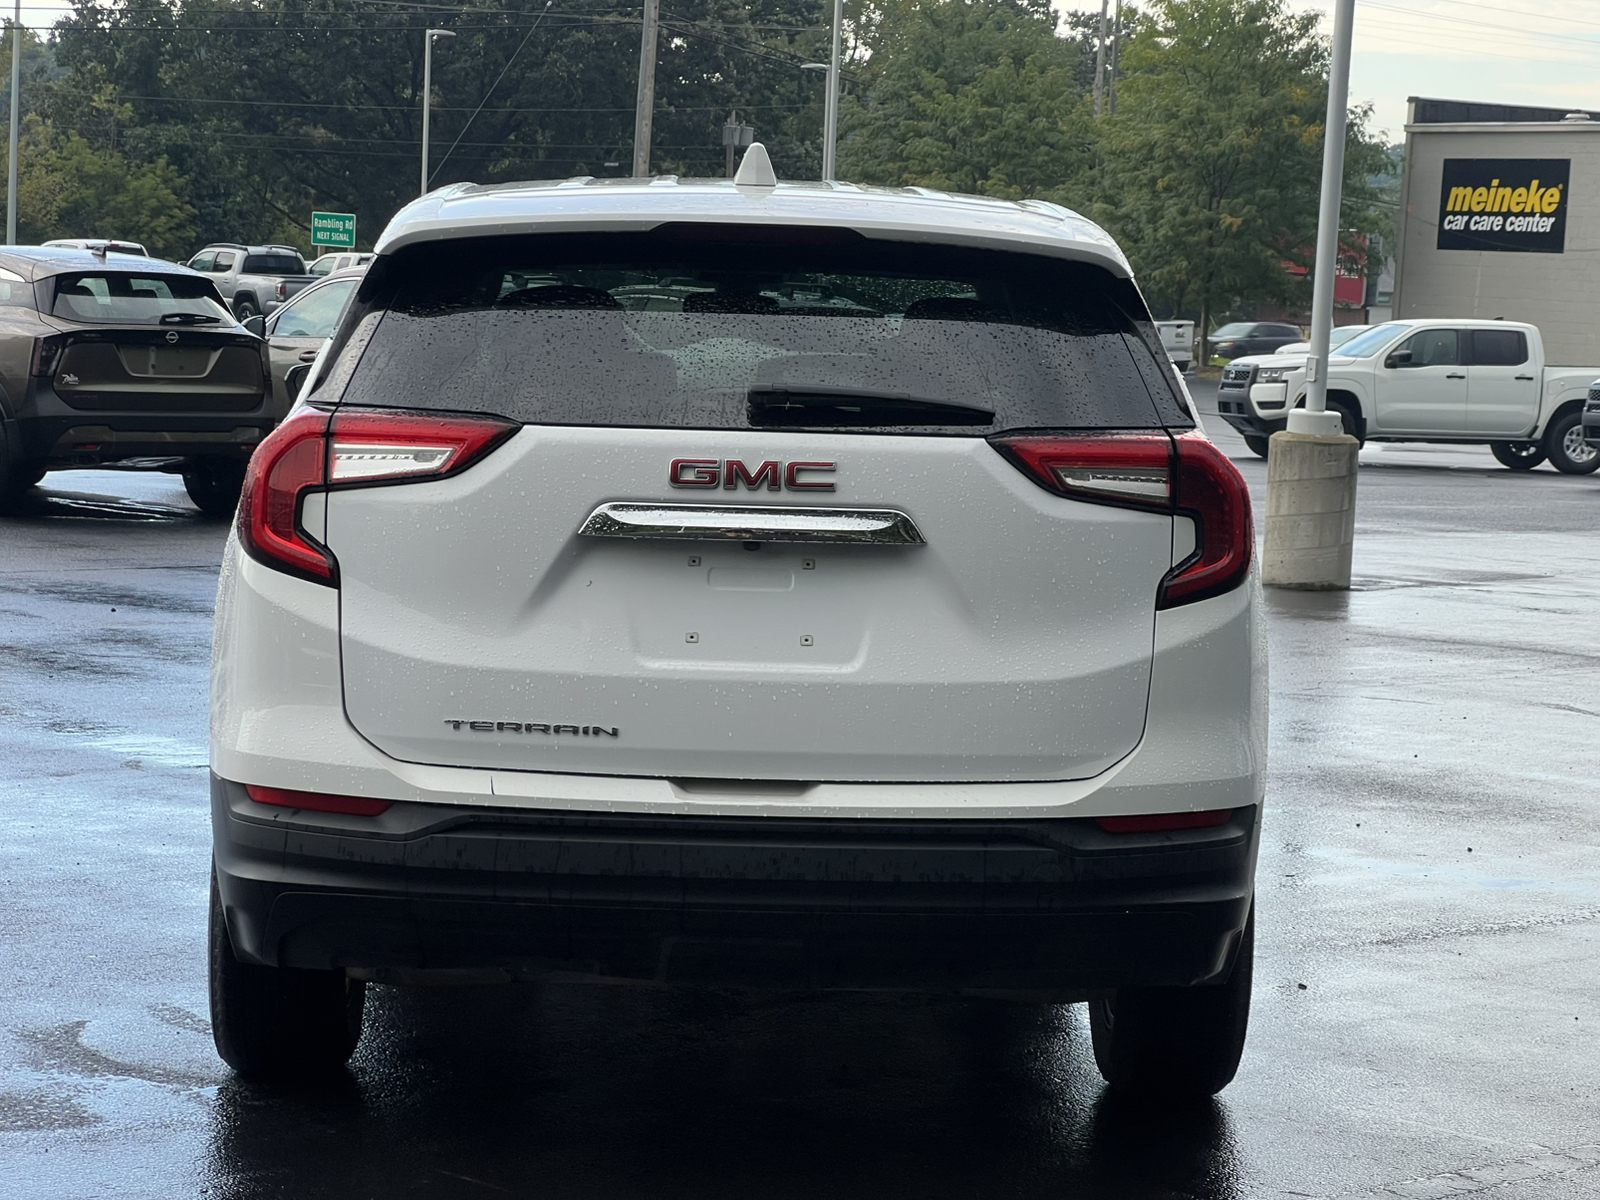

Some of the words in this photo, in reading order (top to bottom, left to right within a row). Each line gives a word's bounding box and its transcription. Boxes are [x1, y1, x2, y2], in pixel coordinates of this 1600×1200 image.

[1446, 179, 1561, 213] meineke
[314, 218, 343, 231] Rambling
[345, 220, 353, 230] Rd
[1443, 214, 1469, 231] car
[1469, 215, 1503, 232] care
[1505, 213, 1556, 233] center
[317, 231, 330, 240] NEXT
[331, 233, 349, 241] SIGNAL
[668, 457, 837, 492] GMC
[443, 718, 619, 739] TERRAIN
